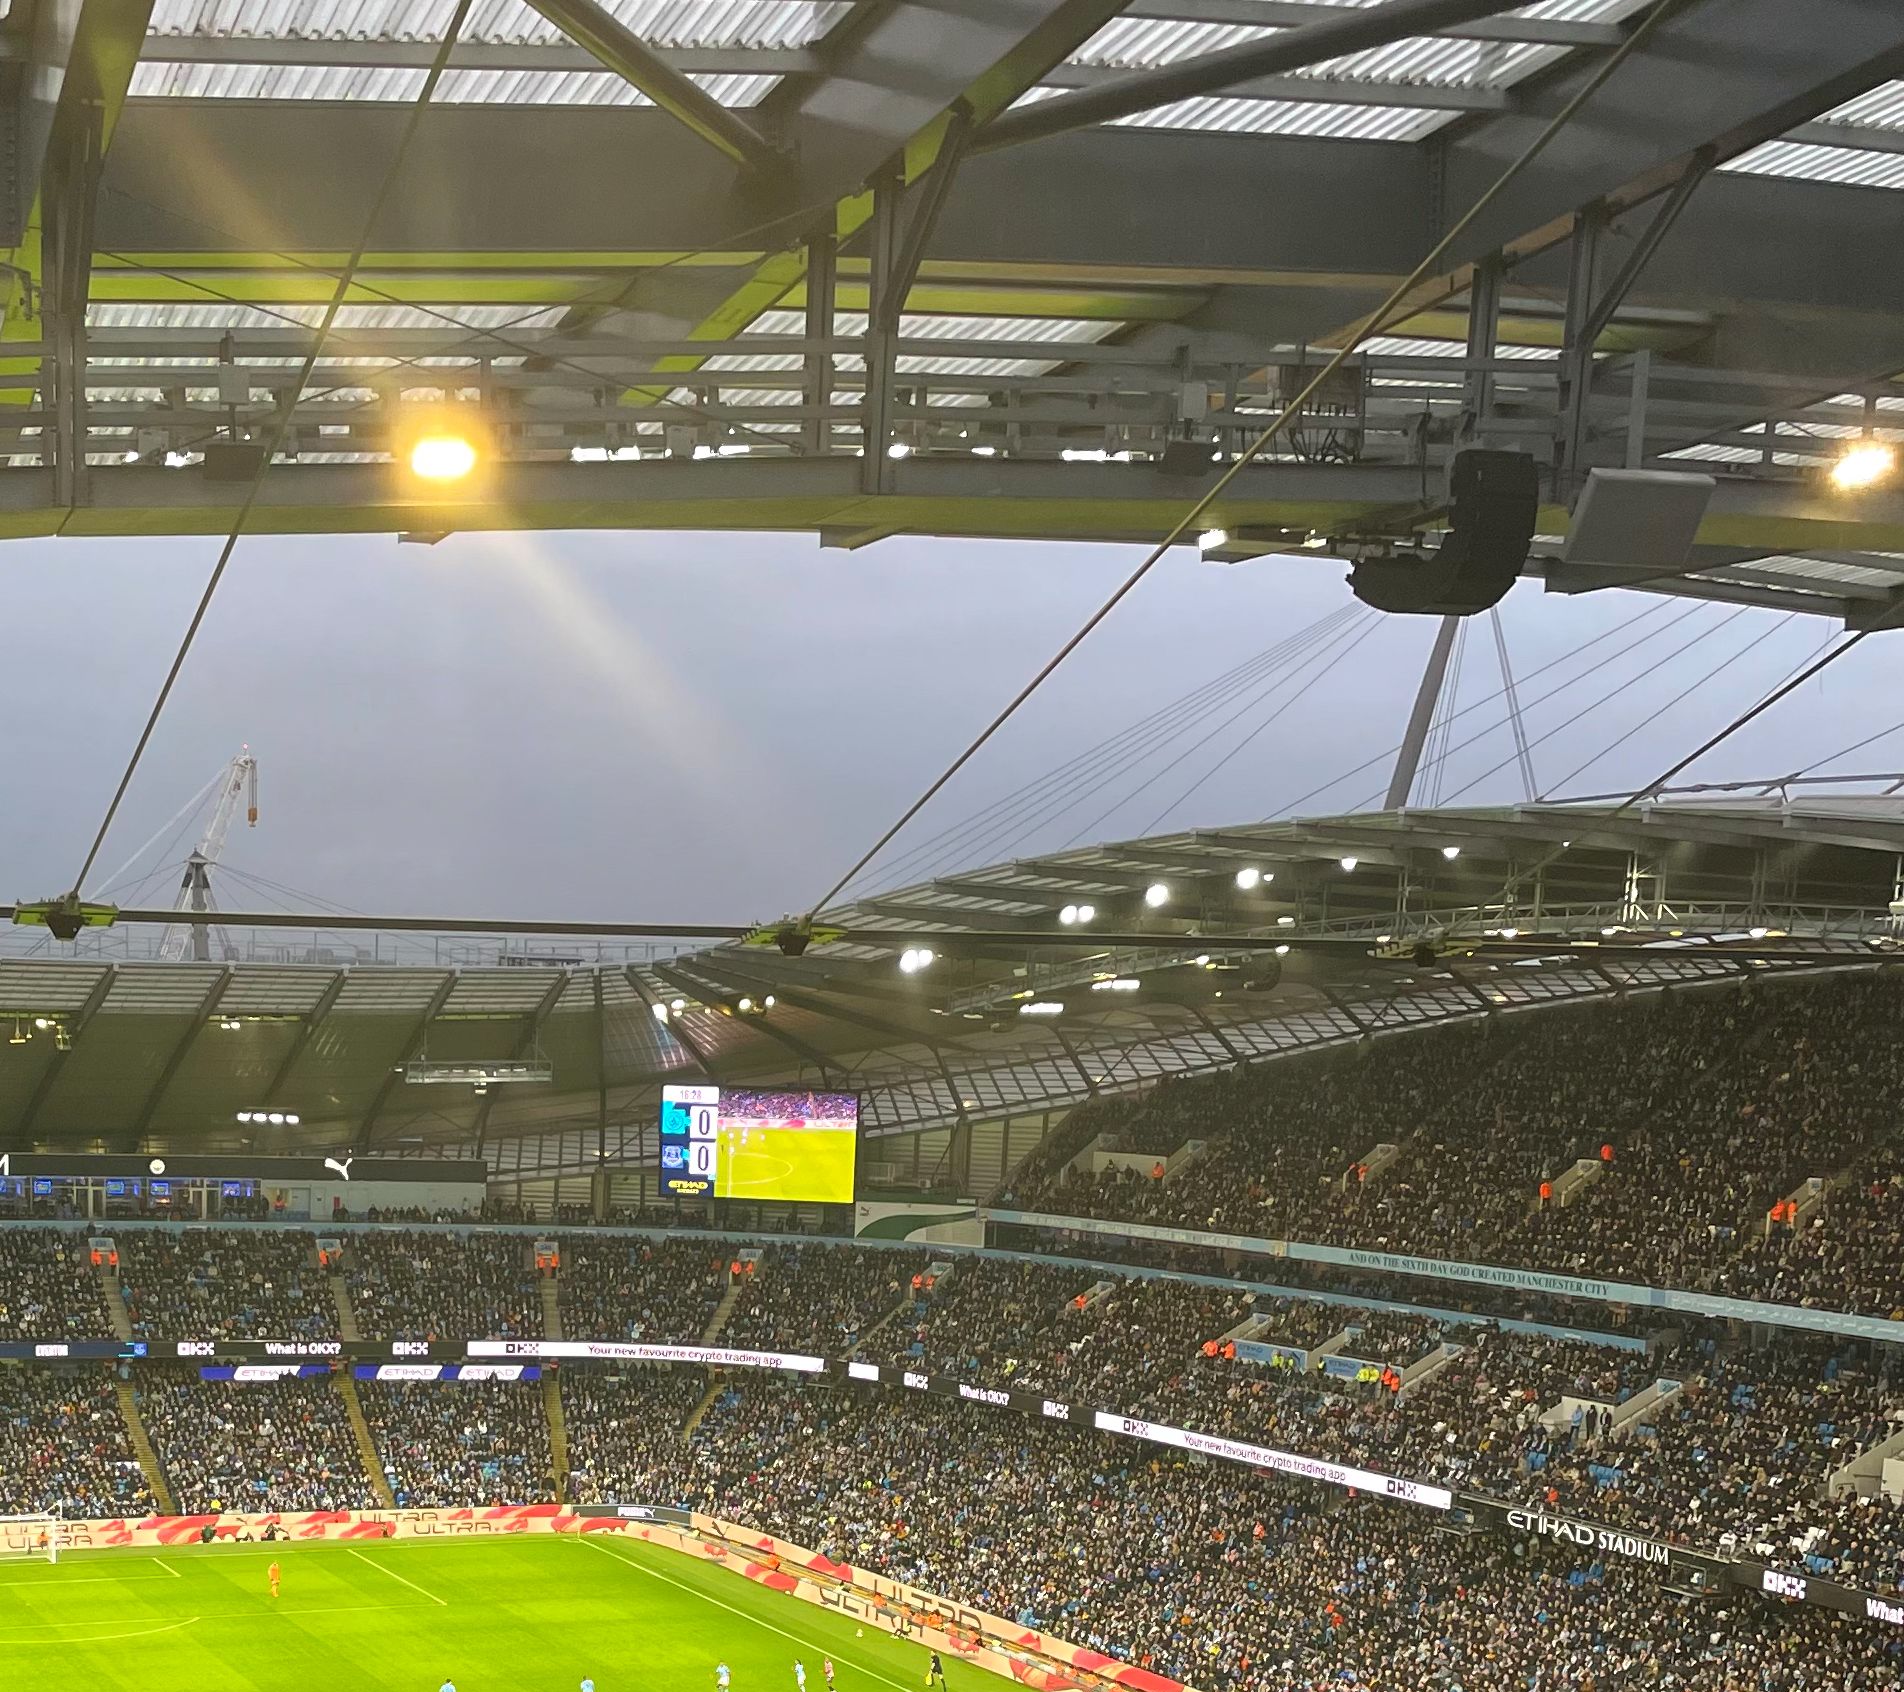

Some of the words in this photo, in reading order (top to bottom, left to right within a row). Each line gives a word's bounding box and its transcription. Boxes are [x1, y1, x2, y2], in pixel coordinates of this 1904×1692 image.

[699, 1109, 711, 1136] 0
[697, 1145, 709, 1171] 0
[1349, 1252, 1367, 1264] AND
[1368, 1255, 1382, 1266] ON
[1383, 1256, 1399, 1268] THE
[1400, 1258, 1430, 1273] SIXTH
[1430, 1262, 1449, 1275] DAY
[1450, 1264, 1471, 1278] GOD
[1472, 1268, 1516, 1284] CREATED
[1516, 1274, 1582, 1294] MANCHESTER
[1584, 1282, 1610, 1296] CITY
[265, 1342, 297, 1355] What
[298, 1343, 308, 1355] is
[308, 1343, 342, 1355] OKX?
[588, 1345, 611, 1354] Your
[615, 1348, 636, 1356] new
[639, 1346, 686, 1358] favourite
[688, 1351, 722, 1362] crypto
[725, 1353, 760, 1365] trading
[764, 1356, 782, 1367] app
[384, 1368, 434, 1377] ETIHAD
[959, 1384, 980, 1400] What
[979, 1388, 987, 1401] is
[1183, 1433, 1203, 1448] Your
[1205, 1440, 1222, 1453] new
[1223, 1443, 1262, 1462] favourite
[1263, 1454, 1292, 1470] crypto
[1294, 1461, 1326, 1477] trading
[1328, 1470, 1346, 1481] app
[1387, 1479, 1417, 1500] OKX
[413, 1522, 492, 1535] ULTRA
[1507, 1510, 1595, 1545] ETIHAD
[1598, 1531, 1669, 1566] STADIUM
[8, 1535, 92, 1549] ULRA
[1866, 1597, 1904, 1625] What
